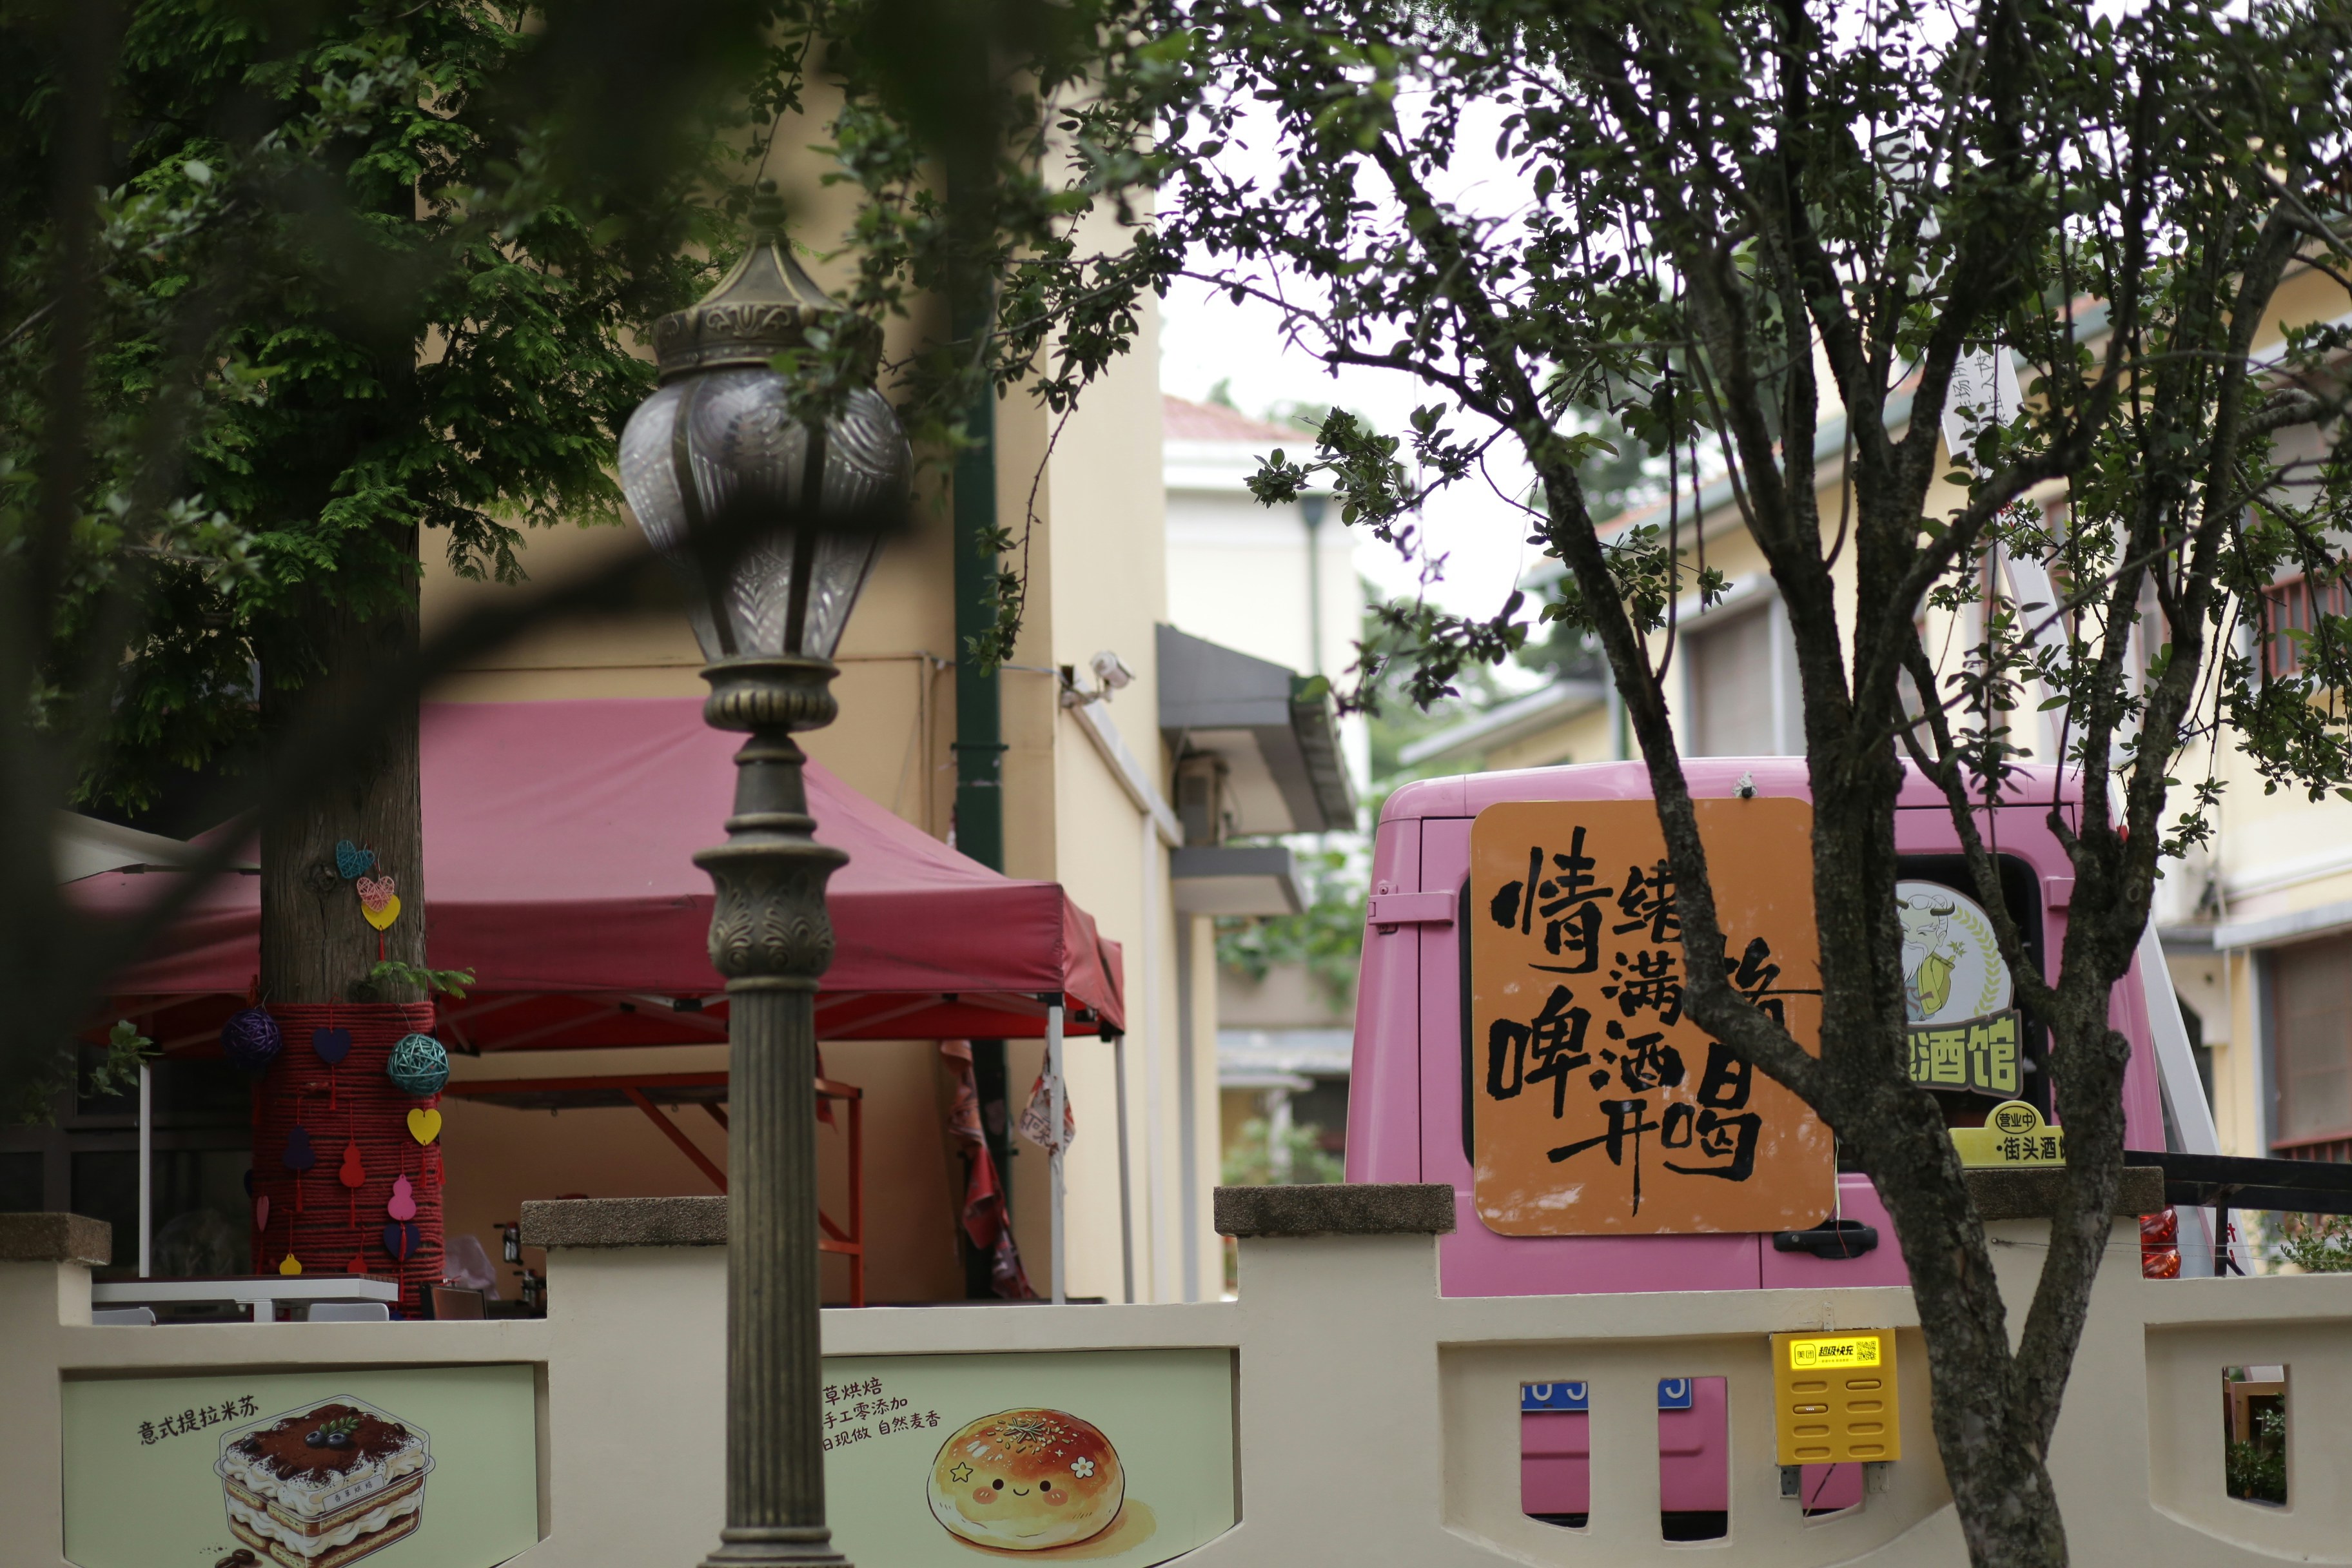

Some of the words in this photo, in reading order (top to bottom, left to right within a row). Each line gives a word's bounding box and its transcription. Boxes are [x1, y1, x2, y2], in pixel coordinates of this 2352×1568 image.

[1908, 1017, 2016, 1092] 酒馆
[1999, 1113, 2033, 1127] 营业中
[1797, 1350, 1814, 1359] 美团
[1818, 1345, 1854, 1357] 超级快充
[823, 1377, 883, 1406] 草烘焙
[137, 1395, 259, 1446] 意式提拉米苏
[823, 1396, 908, 1429] 手工零添加
[823, 1426, 872, 1451] 日现做
[879, 1409, 941, 1435] 自然麦香
